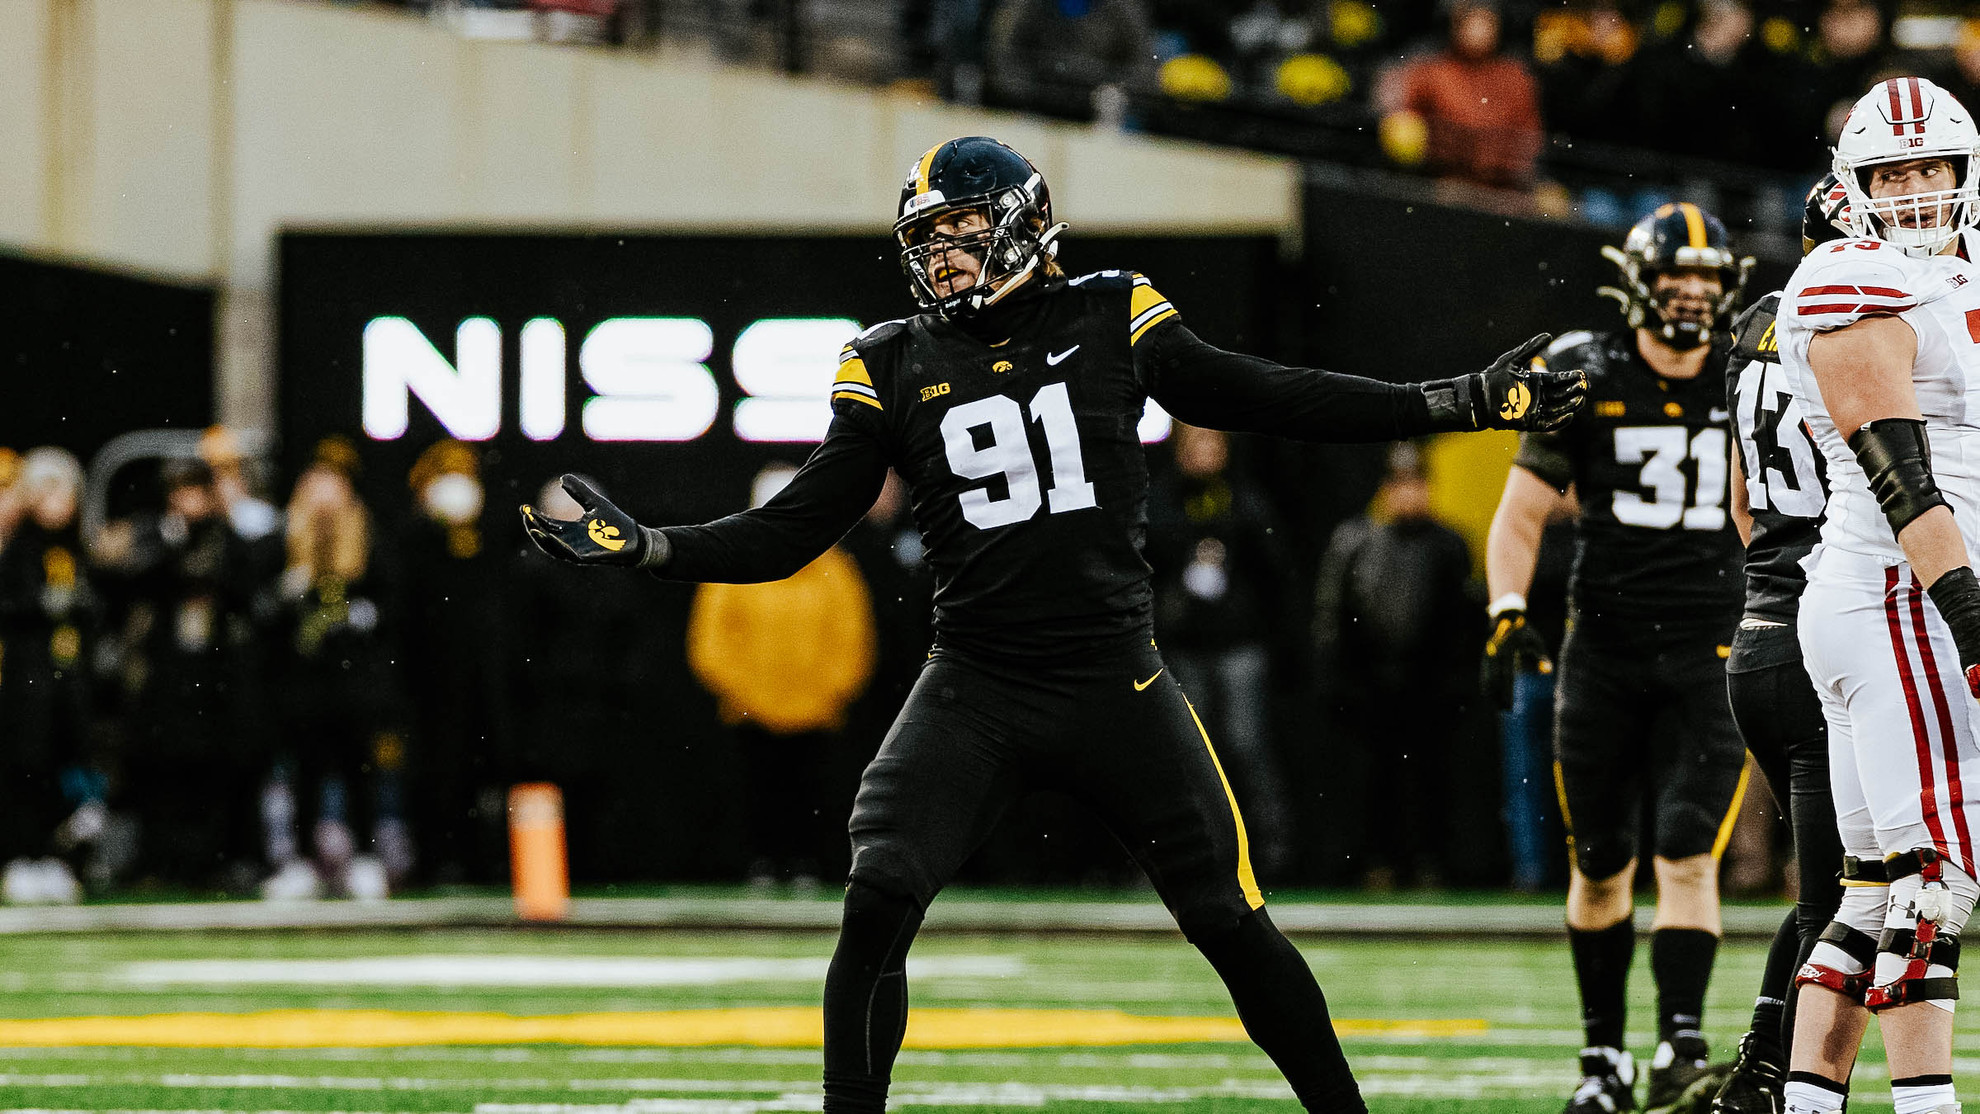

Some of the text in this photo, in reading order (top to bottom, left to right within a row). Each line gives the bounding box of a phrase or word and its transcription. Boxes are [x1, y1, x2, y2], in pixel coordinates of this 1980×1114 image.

[362, 316, 1172, 442] NISS
[1734, 359, 1827, 518] 13
[940, 382, 1097, 530] 91
[1611, 426, 1727, 530] 31
